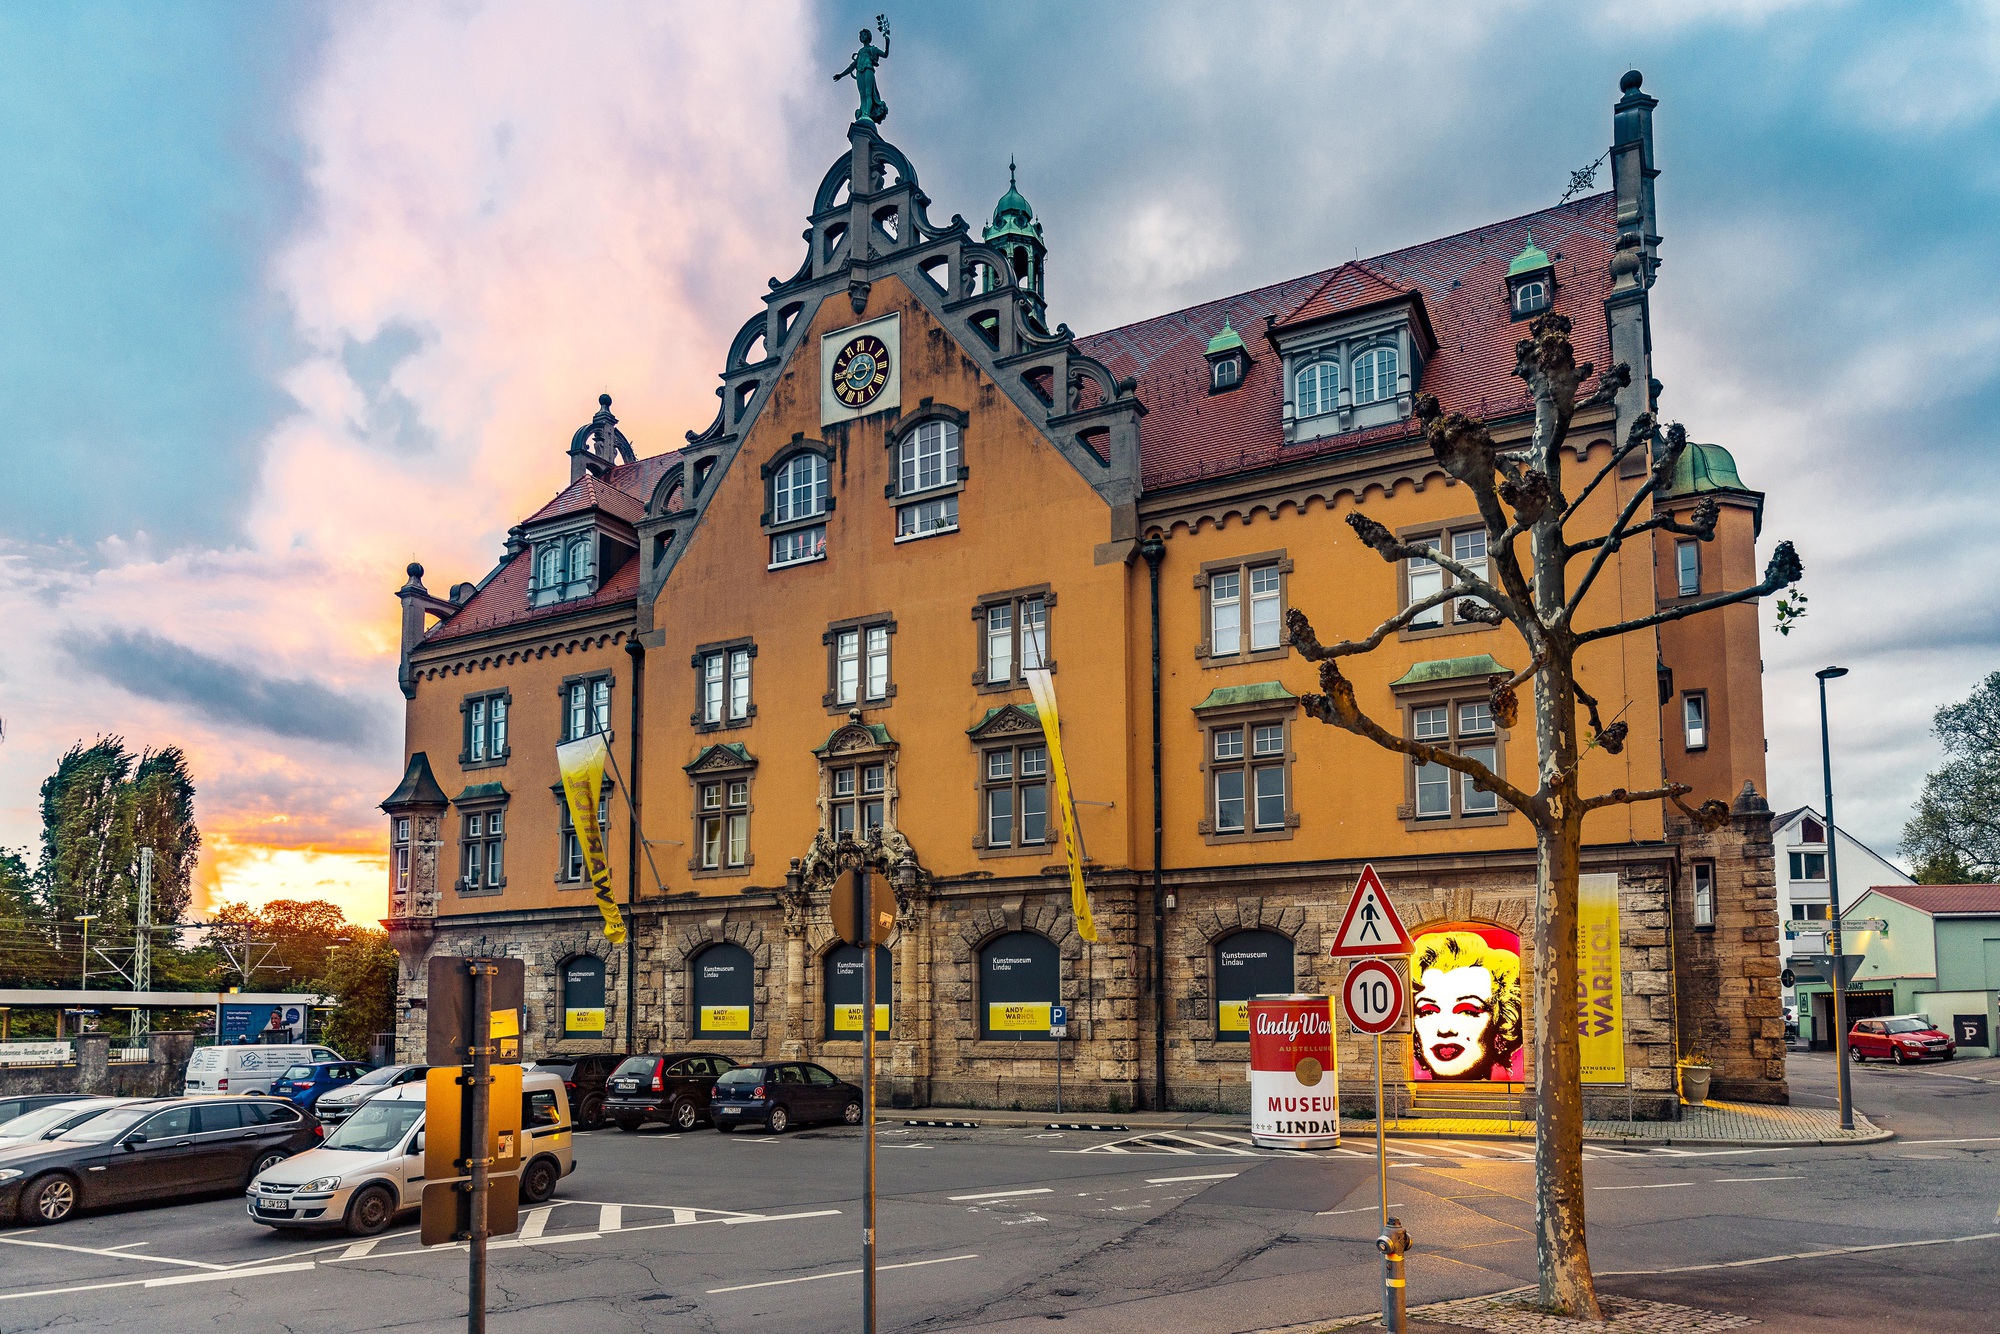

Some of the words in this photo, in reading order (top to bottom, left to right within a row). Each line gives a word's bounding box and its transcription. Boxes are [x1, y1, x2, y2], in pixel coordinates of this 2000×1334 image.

[1221, 951, 1268, 960] Kunstmuseum
[1592, 917, 1614, 1037] WARHOL
[1359, 981, 1388, 1014] 10
[1053, 1008, 1063, 1023] P
[1256, 1012, 1301, 1042] Andy
[1964, 1026, 1977, 1040] P
[1275, 1120, 1337, 1134] LINDAU
[276, 1201, 287, 1209] 123
